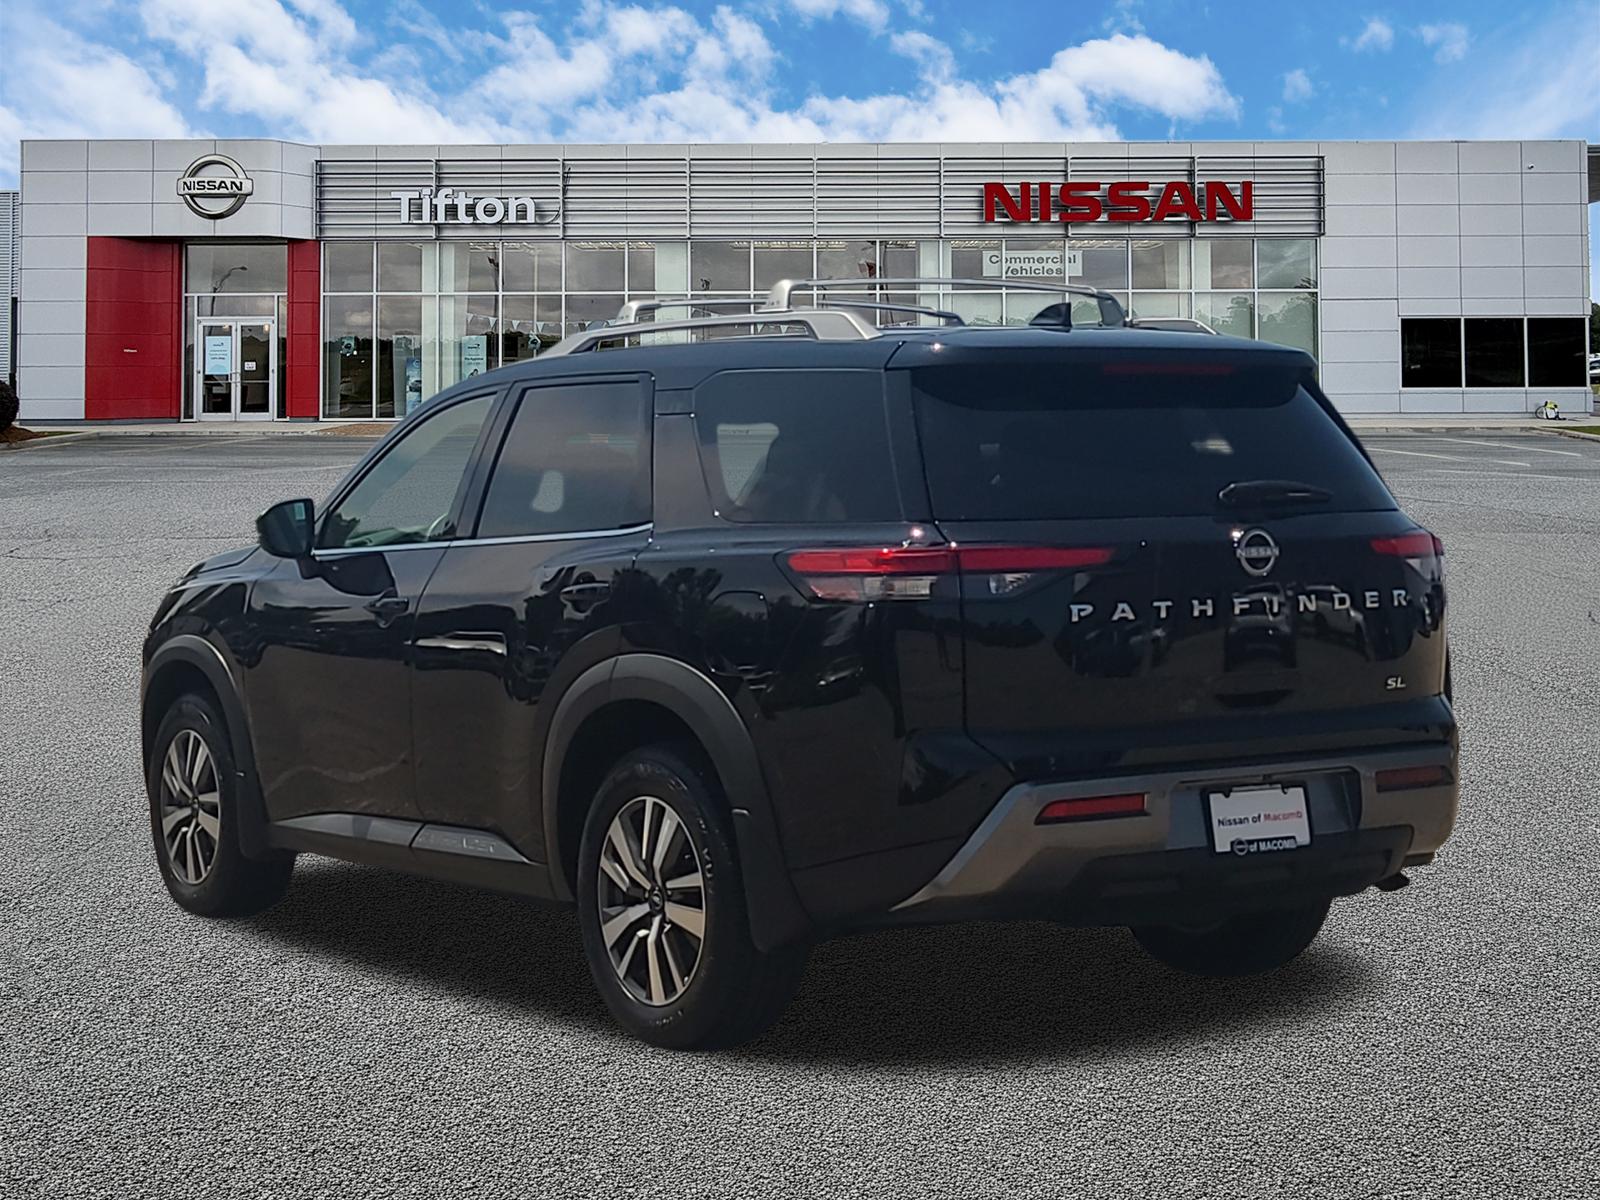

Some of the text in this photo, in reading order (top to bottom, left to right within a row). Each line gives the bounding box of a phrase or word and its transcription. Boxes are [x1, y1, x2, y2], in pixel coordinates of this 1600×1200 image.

[182, 180, 243, 192] NISSAN
[391, 187, 536, 225] Tifton
[984, 181, 1253, 222] NISSAN
[1069, 588, 1408, 623] PATHFINDER
[1386, 676, 1406, 689] SL
[1217, 810, 1303, 827] Nissan of Macomb
[1248, 841, 1257, 852] of
